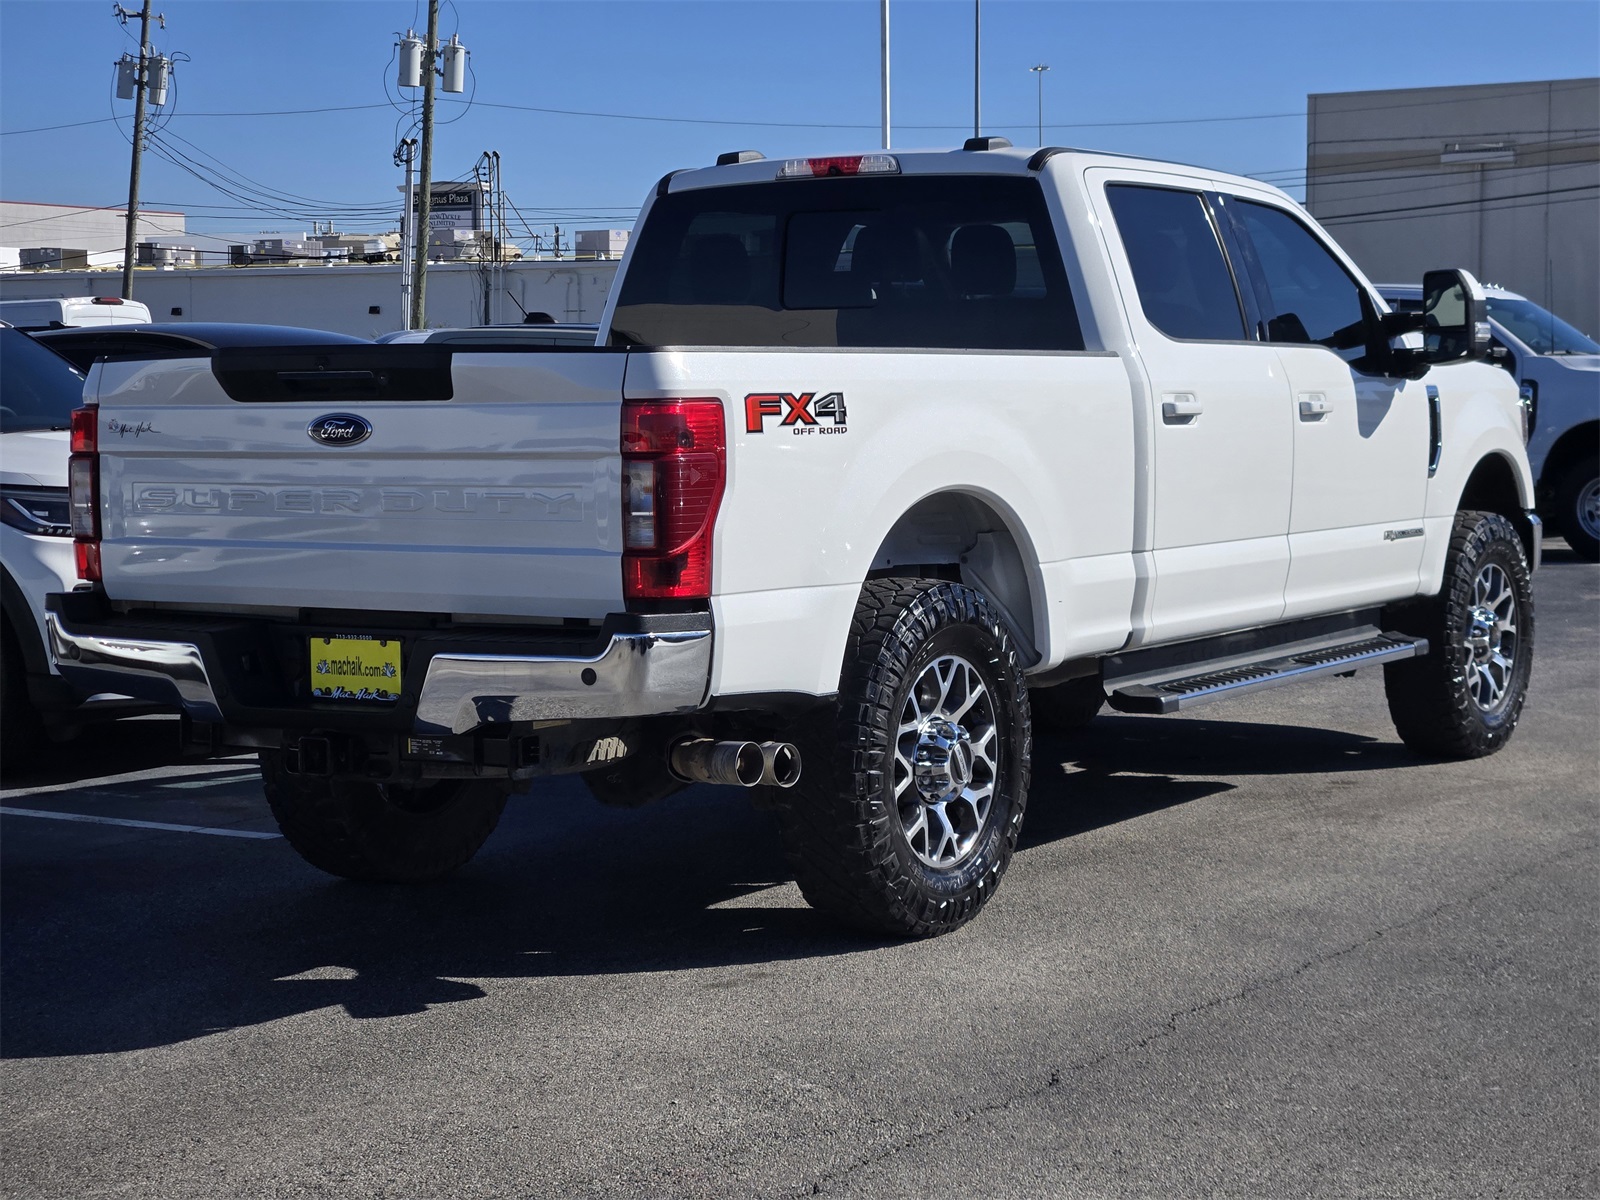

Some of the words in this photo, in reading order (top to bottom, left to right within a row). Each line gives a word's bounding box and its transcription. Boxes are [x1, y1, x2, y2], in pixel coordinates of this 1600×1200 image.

[448, 193, 469, 204] Plaza
[744, 391, 847, 434] FX4
[119, 423, 134, 438] Mac
[320, 420, 354, 439] Ford
[793, 427, 815, 435] OFF
[819, 426, 848, 435] ROAD
[138, 488, 361, 513] SUPER
[379, 489, 576, 514] DUTY
[330, 656, 380, 677] machaik.com
[330, 687, 352, 699] Mac
[355, 688, 384, 700] Haik
